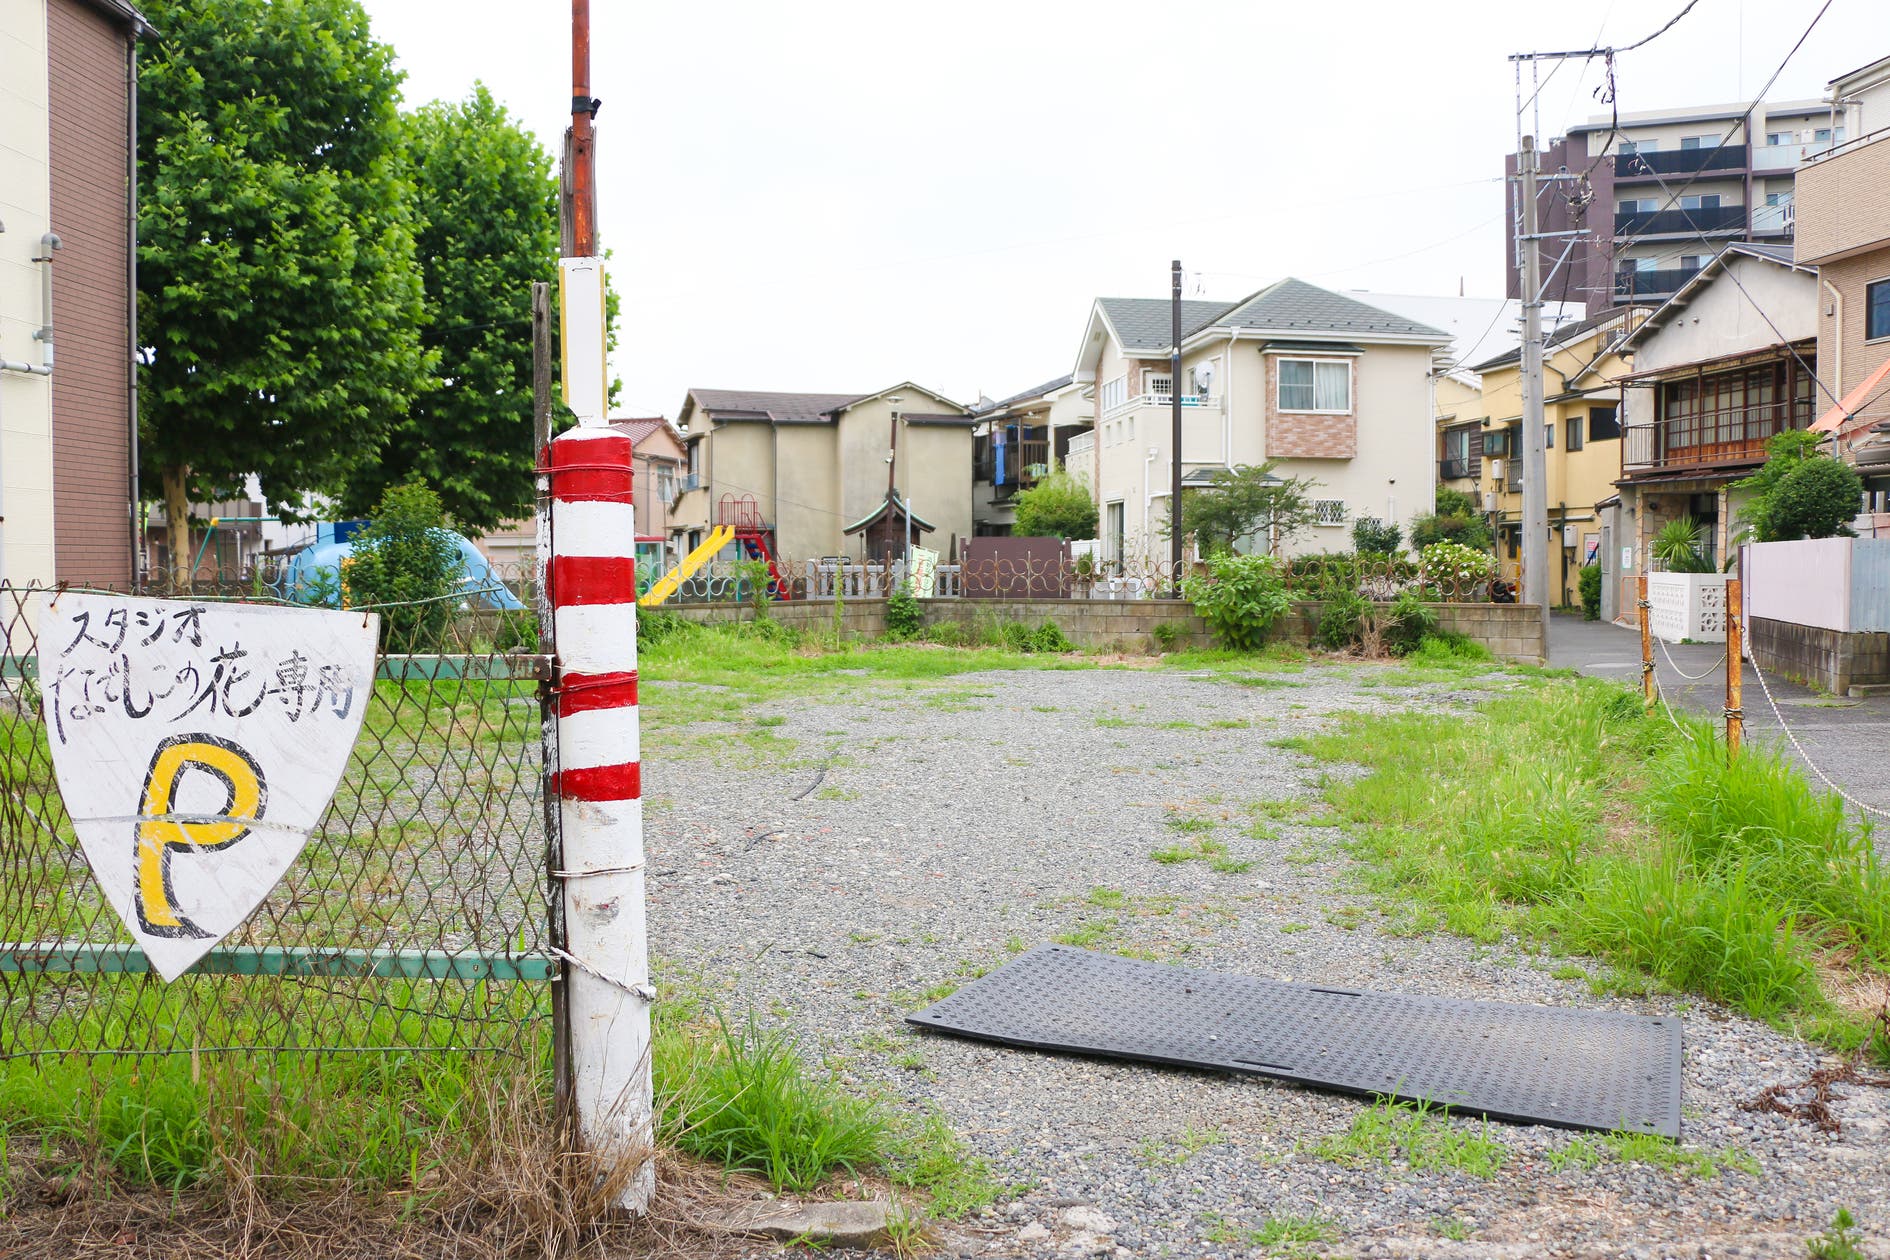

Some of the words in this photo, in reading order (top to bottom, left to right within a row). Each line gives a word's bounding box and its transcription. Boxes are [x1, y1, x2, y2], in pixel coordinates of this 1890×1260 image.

[60, 606, 207, 658] スタジオ
[133, 732, 268, 939] P
